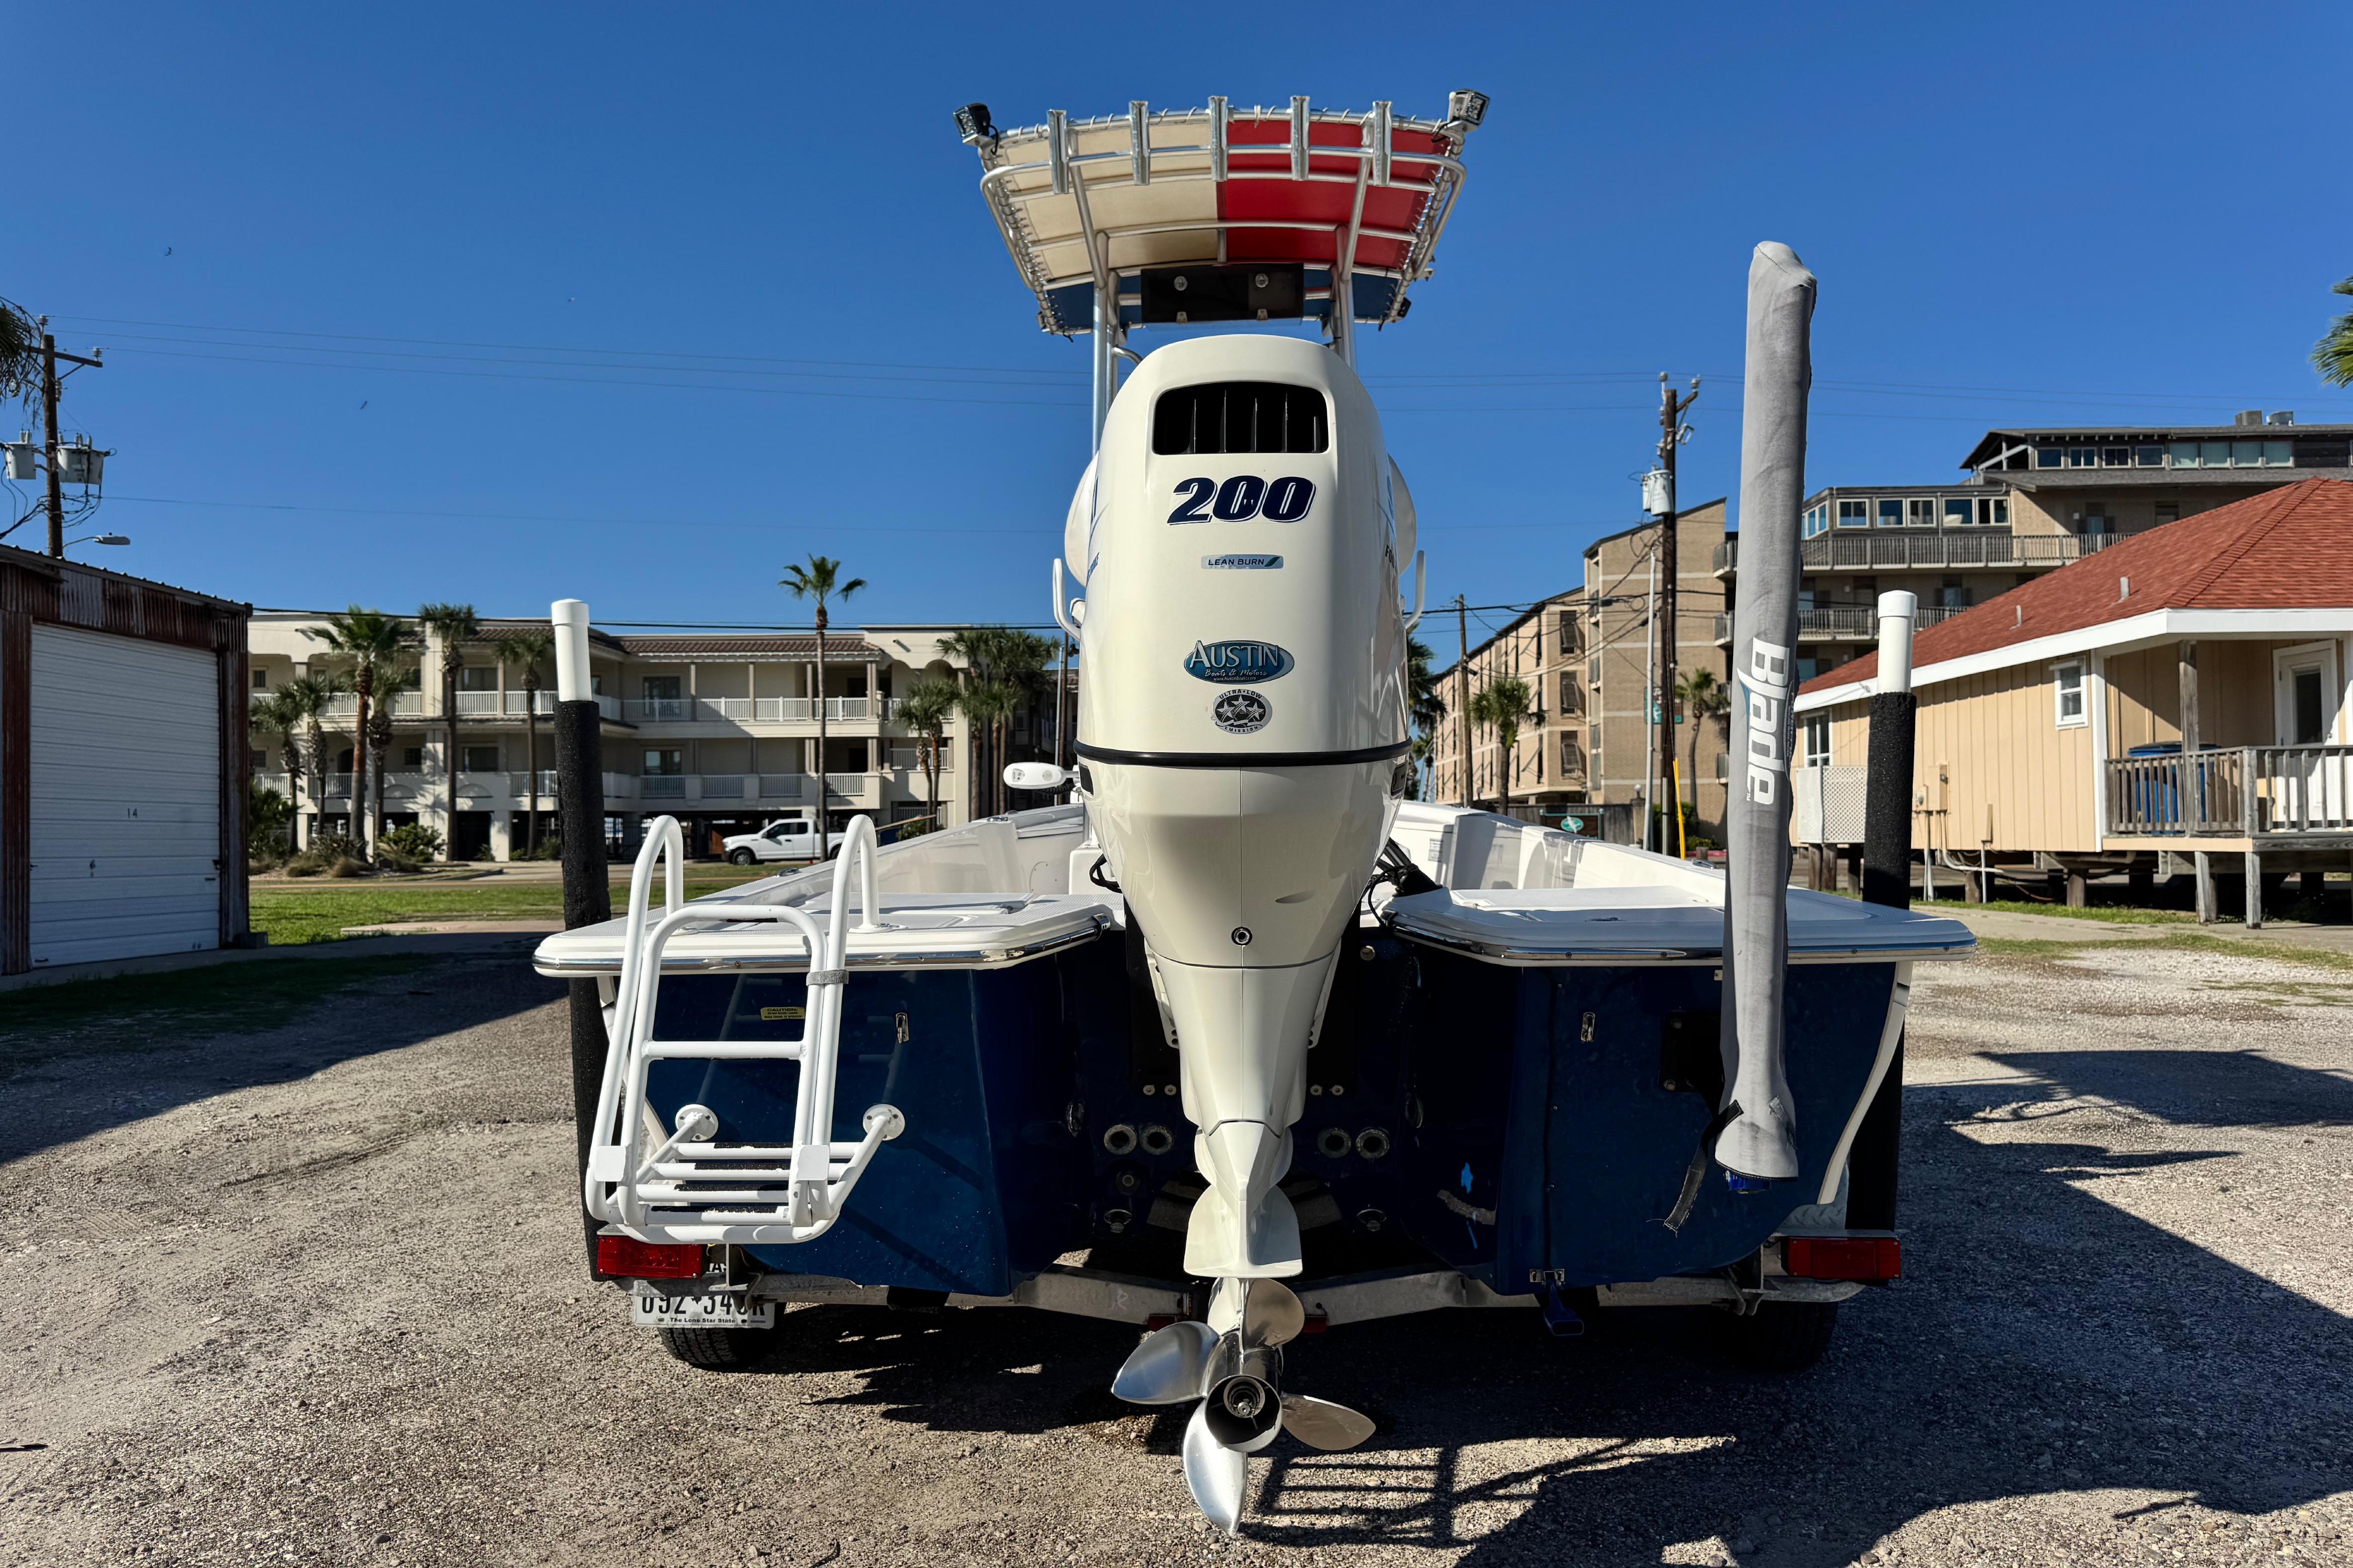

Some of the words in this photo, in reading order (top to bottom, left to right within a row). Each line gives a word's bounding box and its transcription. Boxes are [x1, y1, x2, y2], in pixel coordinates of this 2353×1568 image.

[1167, 475, 1318, 525] 200
[1189, 640, 1279, 668] AUSTIN
[1737, 637, 1790, 805] Blade
